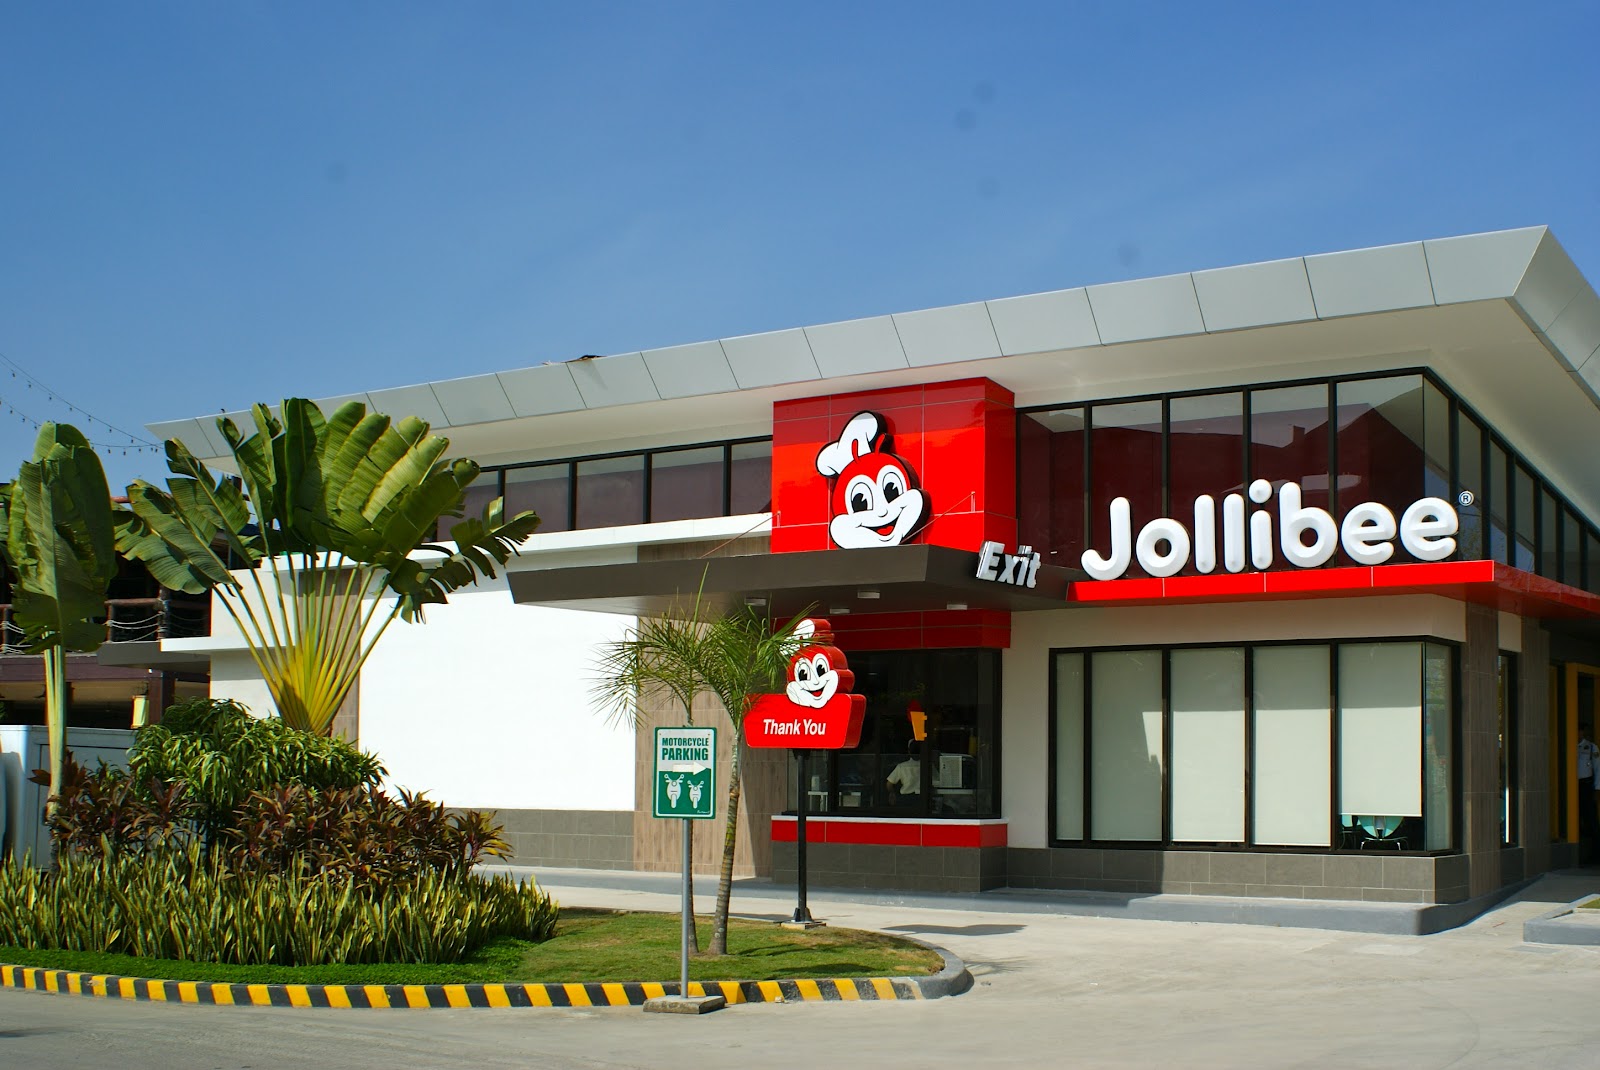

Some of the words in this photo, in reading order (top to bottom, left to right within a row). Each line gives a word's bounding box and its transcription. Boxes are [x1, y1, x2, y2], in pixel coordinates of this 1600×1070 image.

[1081, 478, 1459, 581] Jollibee
[976, 540, 1041, 589] Exit
[763, 719, 801, 735] Thank
[803, 719, 826, 736] You
[661, 737, 709, 747] MOTORCYCLE
[661, 747, 709, 761] PARKING
